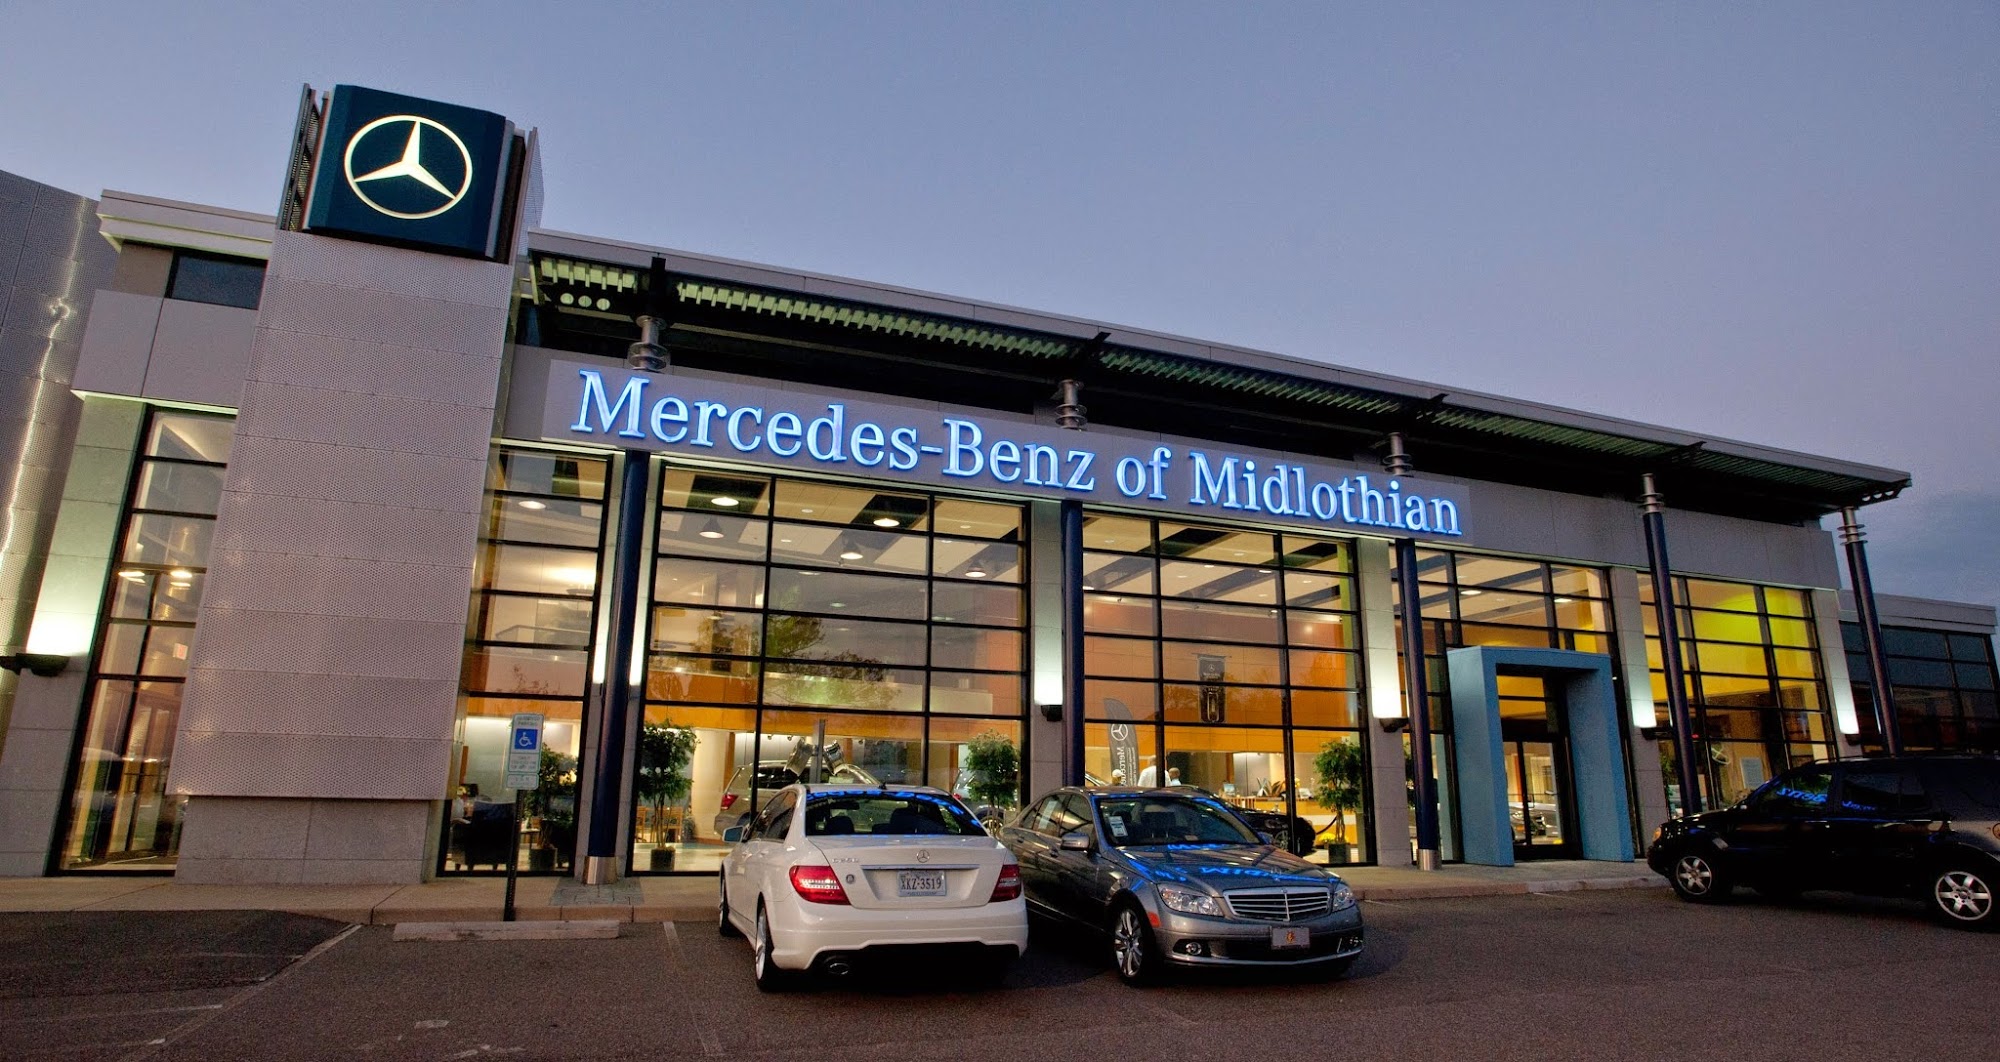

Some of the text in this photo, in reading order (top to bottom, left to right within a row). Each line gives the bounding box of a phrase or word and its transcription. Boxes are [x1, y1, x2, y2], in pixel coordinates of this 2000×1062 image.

[570, 368, 1463, 536] Mercedes-Benz of Midlothian
